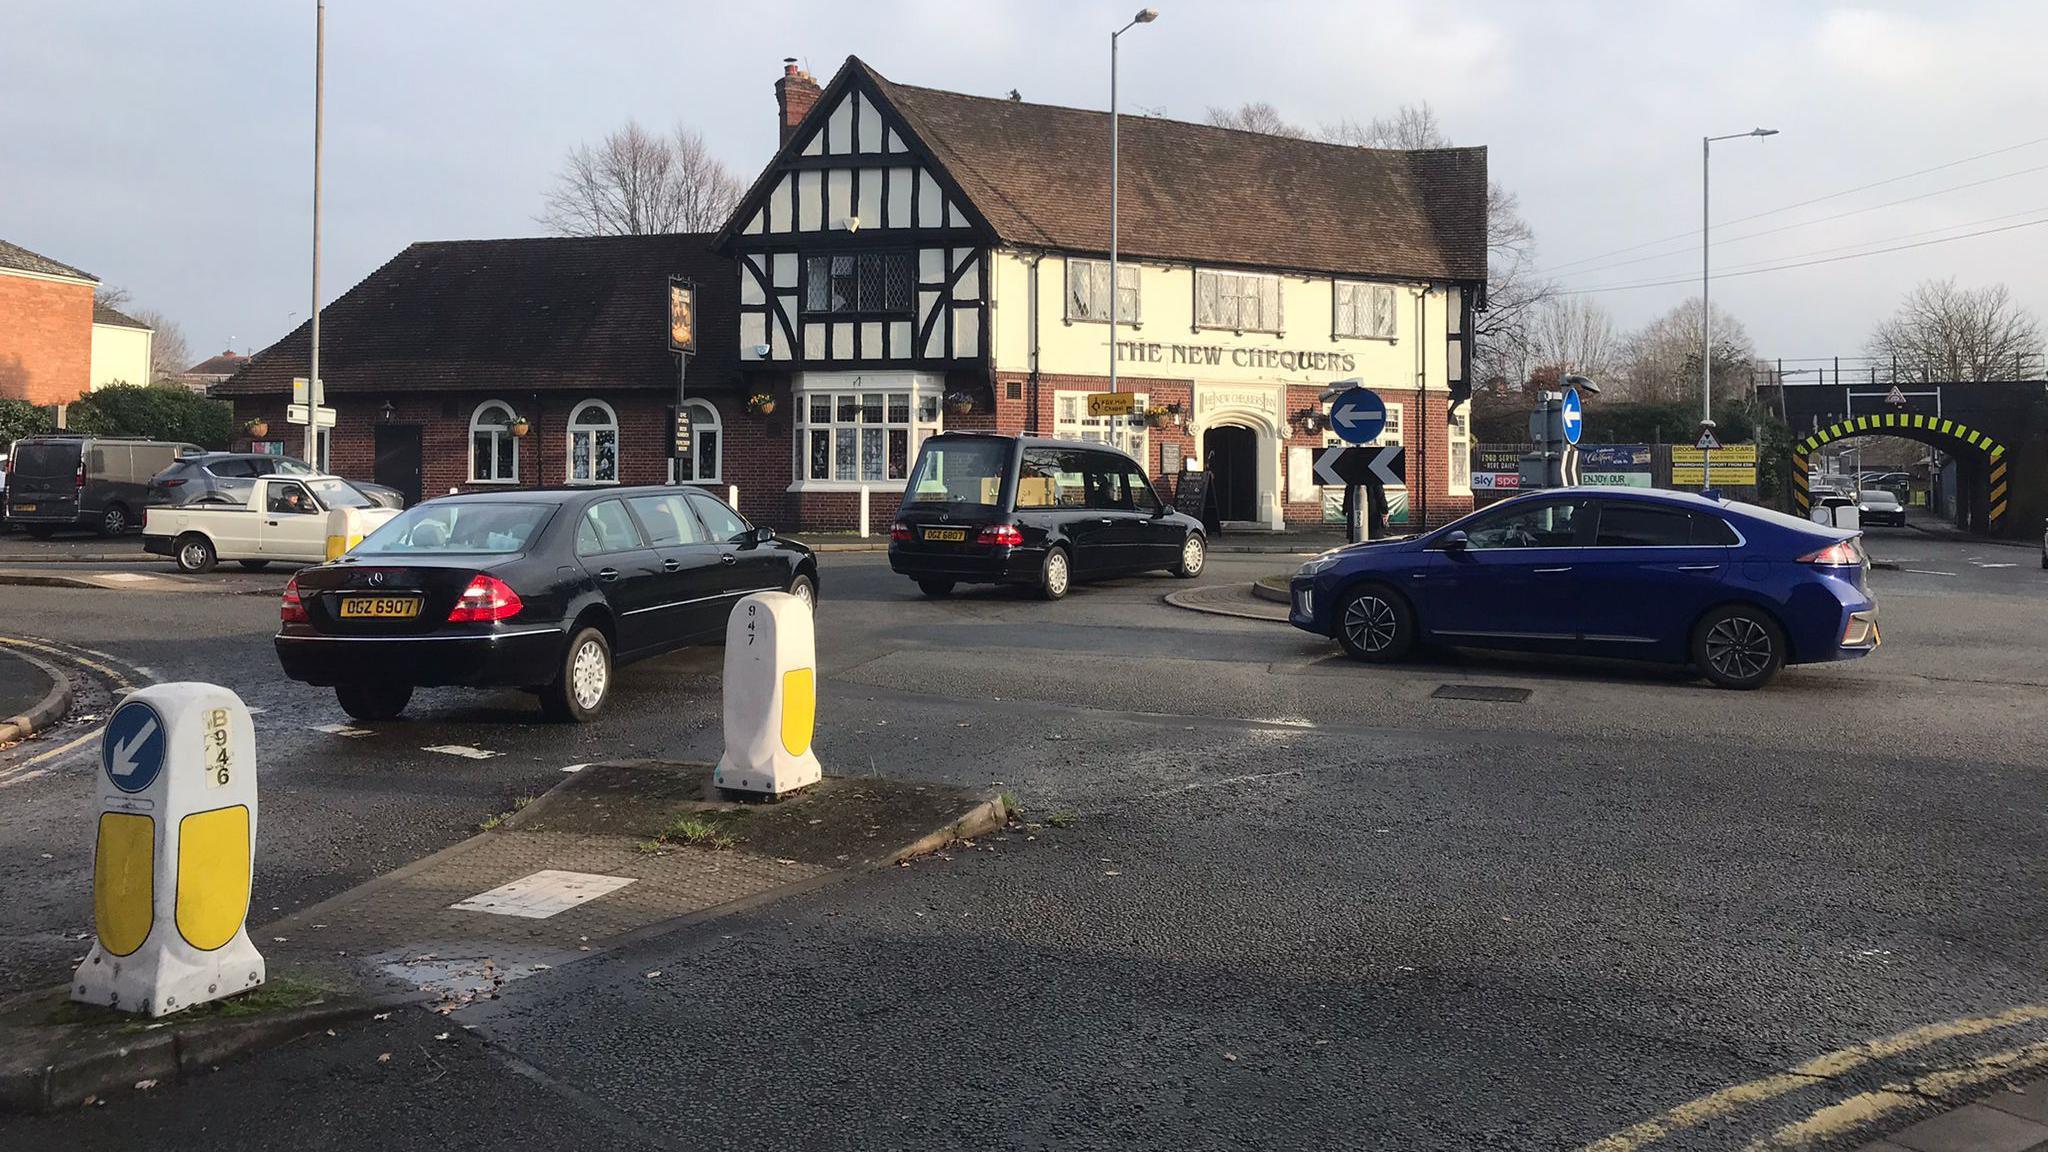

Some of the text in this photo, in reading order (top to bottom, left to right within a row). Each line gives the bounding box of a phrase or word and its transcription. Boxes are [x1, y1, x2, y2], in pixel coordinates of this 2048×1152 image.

[1116, 341, 1356, 373] THE NEW CHEQUERS
[1481, 454, 1497, 462] FOOD
[1474, 475, 1518, 487] sky spo
[1583, 475, 1625, 483] ENJOY OUR
[347, 600, 413, 614] OGZ 6907
